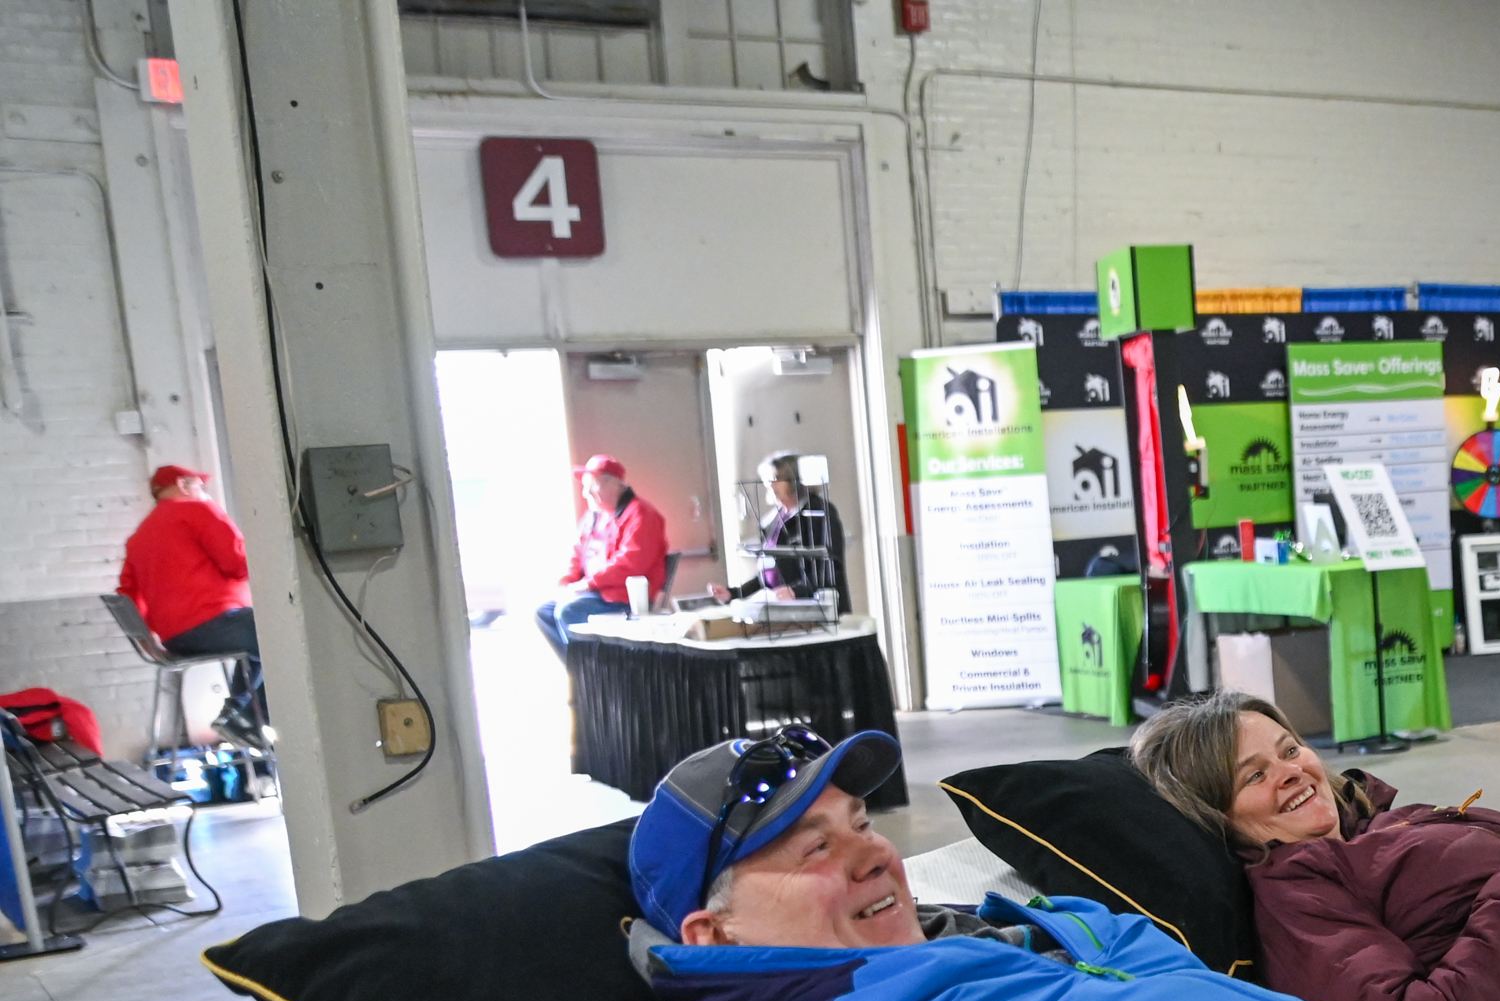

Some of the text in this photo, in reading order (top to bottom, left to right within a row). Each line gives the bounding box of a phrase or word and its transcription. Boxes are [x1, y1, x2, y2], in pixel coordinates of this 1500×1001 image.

[512, 155, 581, 239] 4
[1293, 360, 1330, 377] Mass
[1378, 355, 1442, 376] Offerings
[1231, 465, 1263, 475] mass
[966, 500, 1034, 512] Assessments
[1050, 502, 1090, 514] merican
[960, 541, 1011, 551] Insulation
[1008, 576, 1047, 588] Sealing
[940, 616, 985, 626] Ductless
[971, 649, 1019, 658] Windows
[1364, 658, 1397, 670] mss
[960, 669, 1020, 680] Commercial
[952, 681, 1042, 693] Private Insulation
